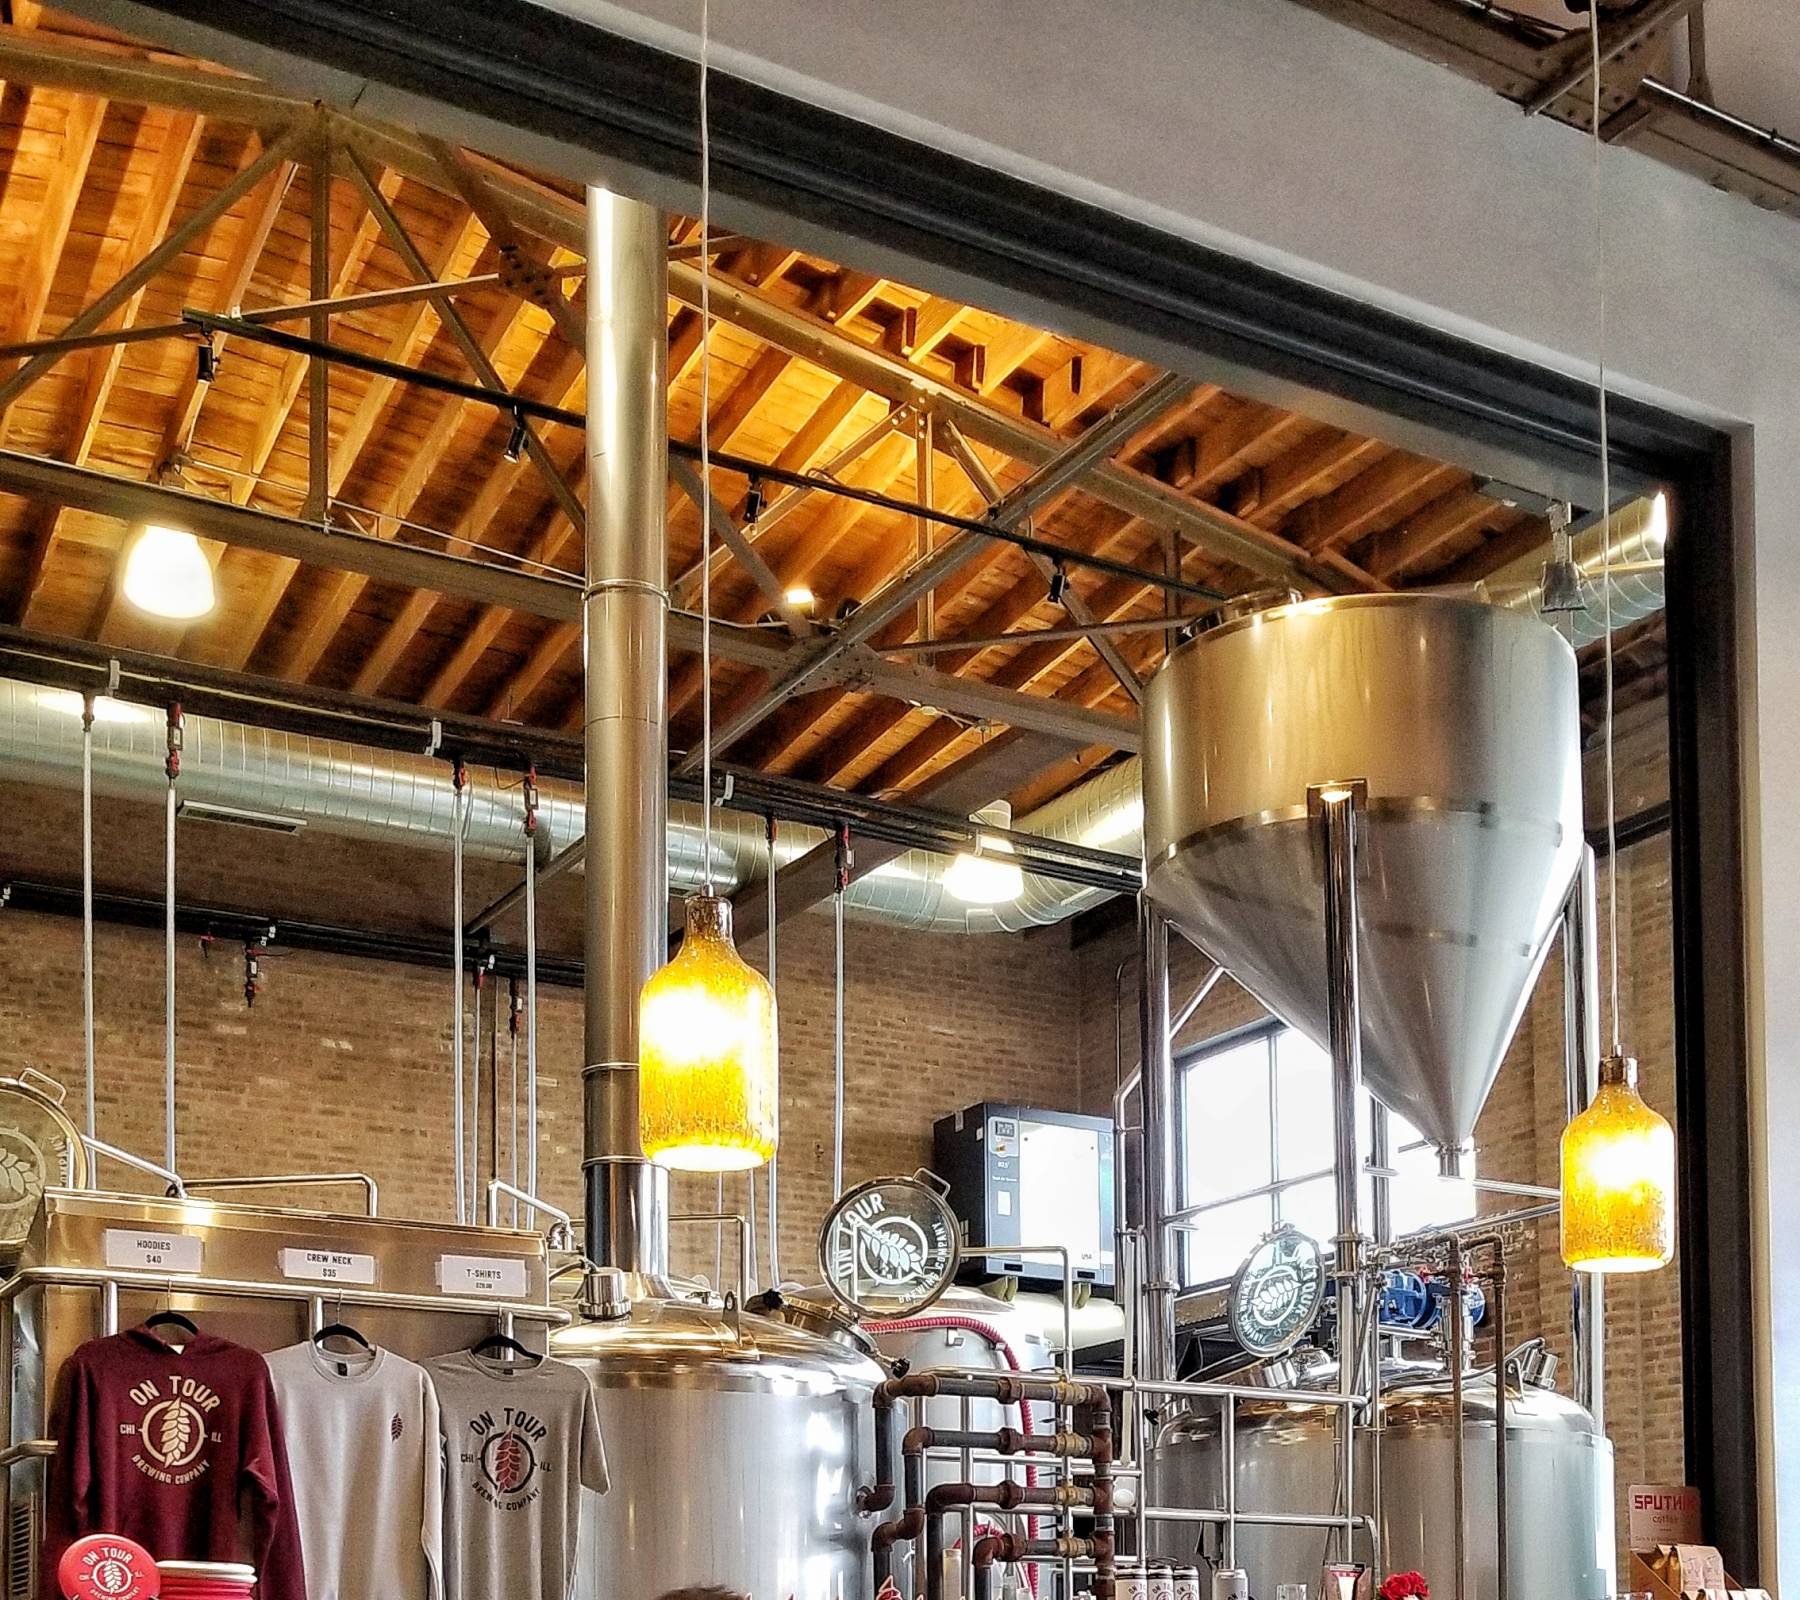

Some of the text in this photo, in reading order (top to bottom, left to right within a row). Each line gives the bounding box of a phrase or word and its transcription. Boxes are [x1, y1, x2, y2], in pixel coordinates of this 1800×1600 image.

[838, 1193, 885, 1236] TOUR
[136, 1239, 171, 1251] HOODIES
[146, 1254, 162, 1264] $40
[306, 1253, 353, 1266] CREW NECK
[322, 1268, 337, 1278] $35
[466, 1268, 502, 1280] T-SHIRTS
[129, 1375, 221, 1413] ON TOUR
[119, 1424, 136, 1435] CHI
[469, 1407, 547, 1442] ON TOUR
[131, 1454, 210, 1485] BREWING COMPANY
[460, 1453, 552, 1472] CHI ILL
[82, 1547, 133, 1566] ON TOUR
